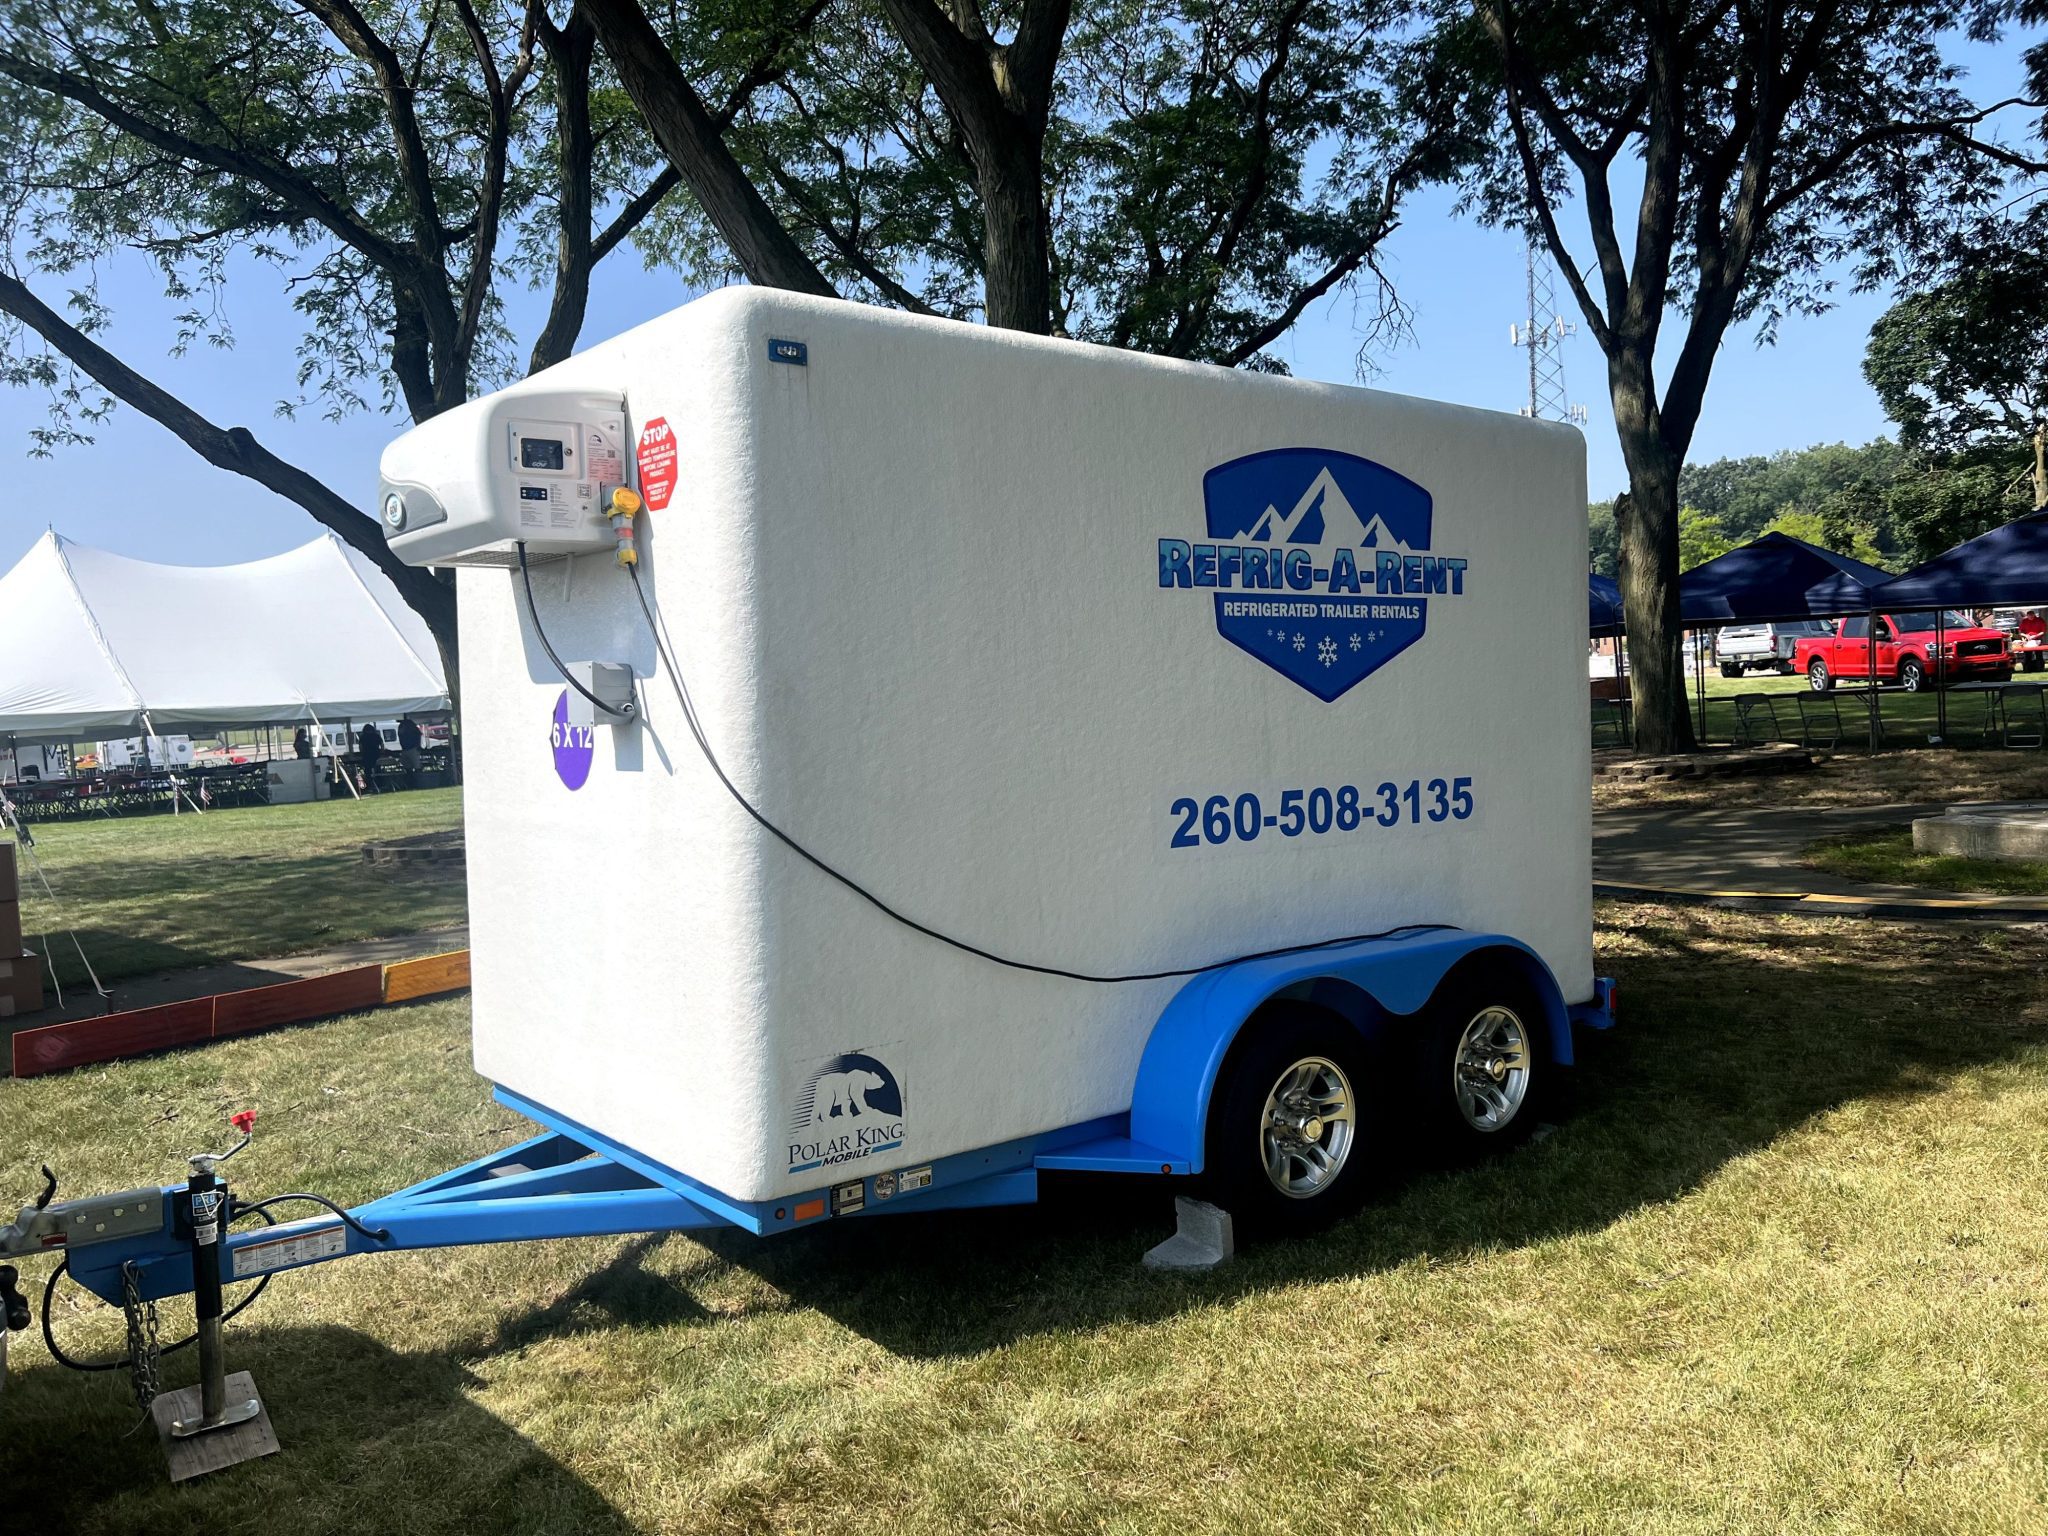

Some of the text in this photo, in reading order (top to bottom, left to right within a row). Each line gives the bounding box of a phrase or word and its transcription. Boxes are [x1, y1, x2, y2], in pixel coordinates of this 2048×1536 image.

[643, 423, 669, 446] STOP
[1224, 601, 1420, 620] REFRIGERATED TRAILER RENTALS
[552, 722, 593, 749] 6 X 12
[1170, 777, 1474, 849] 260-508-3135
[788, 1123, 904, 1165] POLAR KING
[822, 1147, 872, 1167] MOBILE
